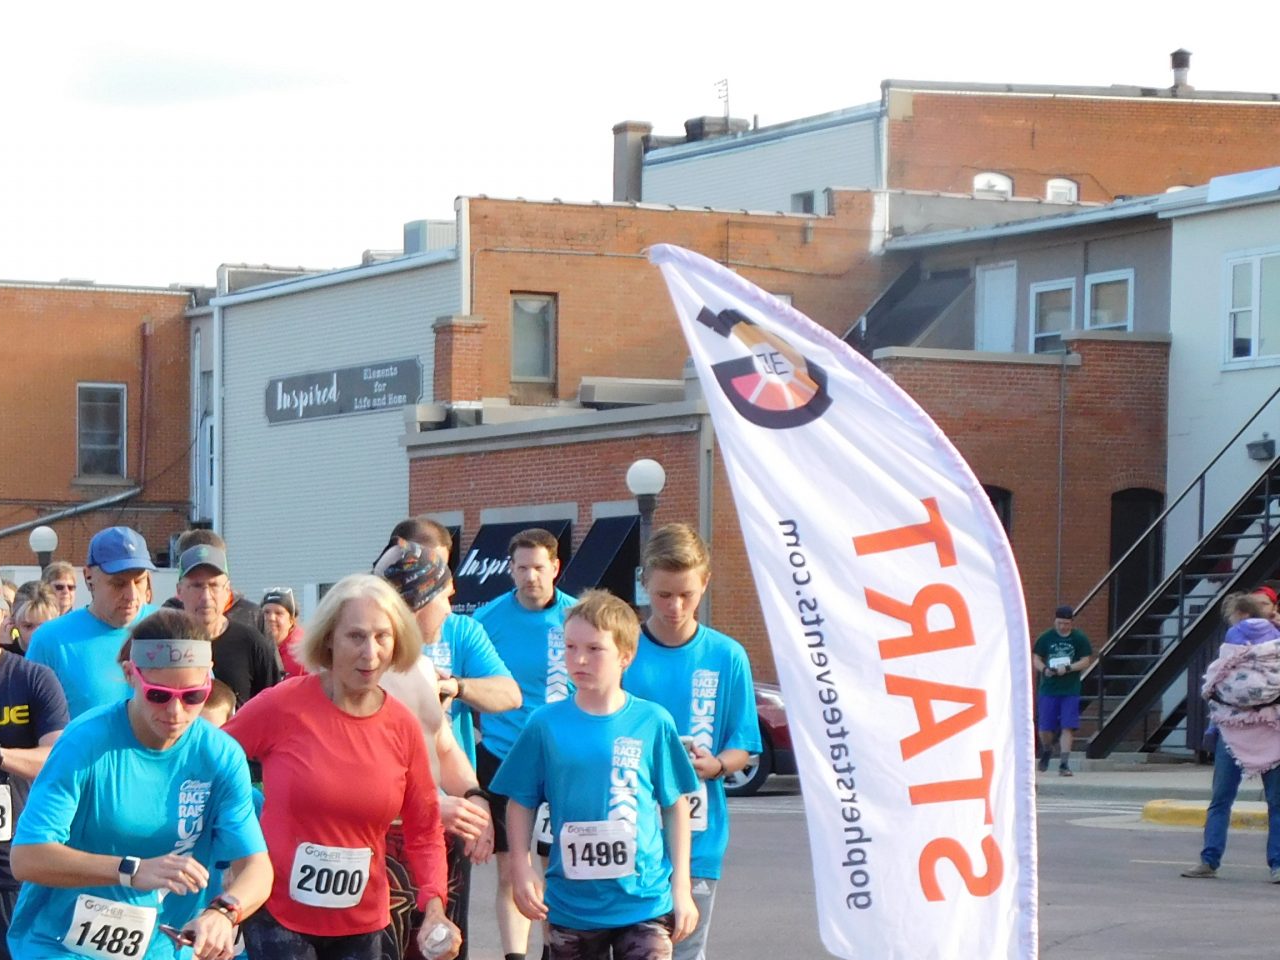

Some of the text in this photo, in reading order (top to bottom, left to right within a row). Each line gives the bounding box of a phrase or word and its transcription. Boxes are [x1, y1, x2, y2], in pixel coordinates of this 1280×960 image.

[363, 366, 399, 380] Elements
[374, 381, 387, 393] for
[276, 372, 341, 417] Inspired
[354, 393, 407, 409] Life and Home
[690, 699, 716, 734] 5K
[608, 768, 639, 807] 5K
[567, 840, 628, 867] 1496
[297, 864, 364, 895] 2000
[76, 921, 144, 957] 1483
